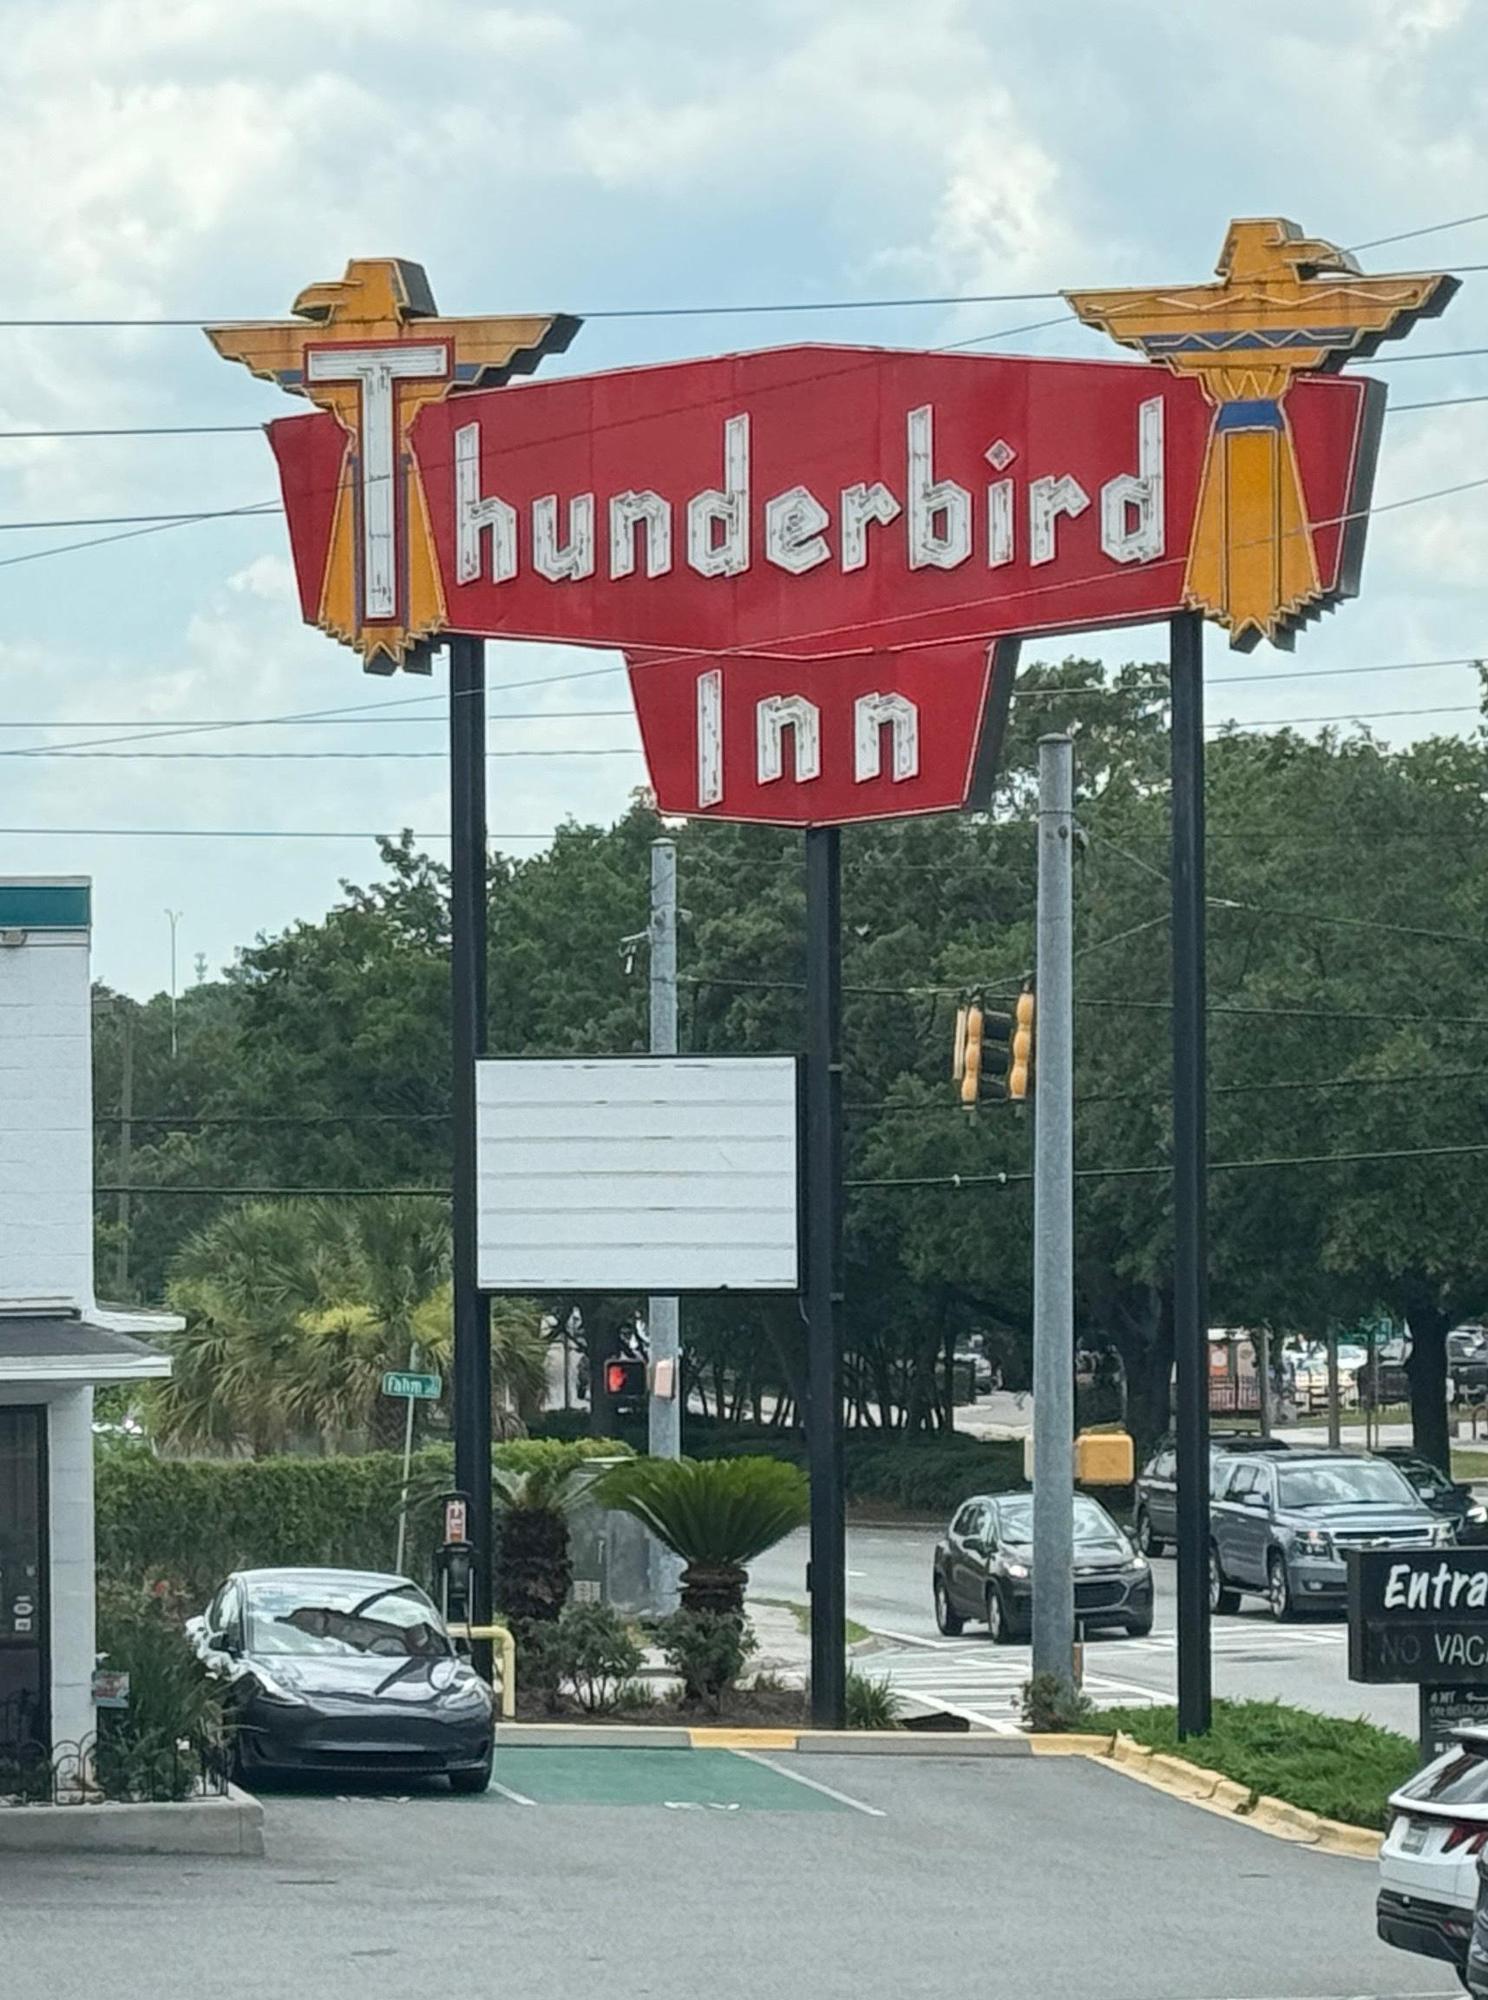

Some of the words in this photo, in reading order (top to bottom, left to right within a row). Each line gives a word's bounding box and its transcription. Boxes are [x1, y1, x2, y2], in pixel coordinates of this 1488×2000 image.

[308, 345, 1165, 619] Thunderbird
[697, 669, 918, 809] Inn
[1380, 1634, 1422, 1666] NO
[1434, 1633, 1488, 1666] VAC
